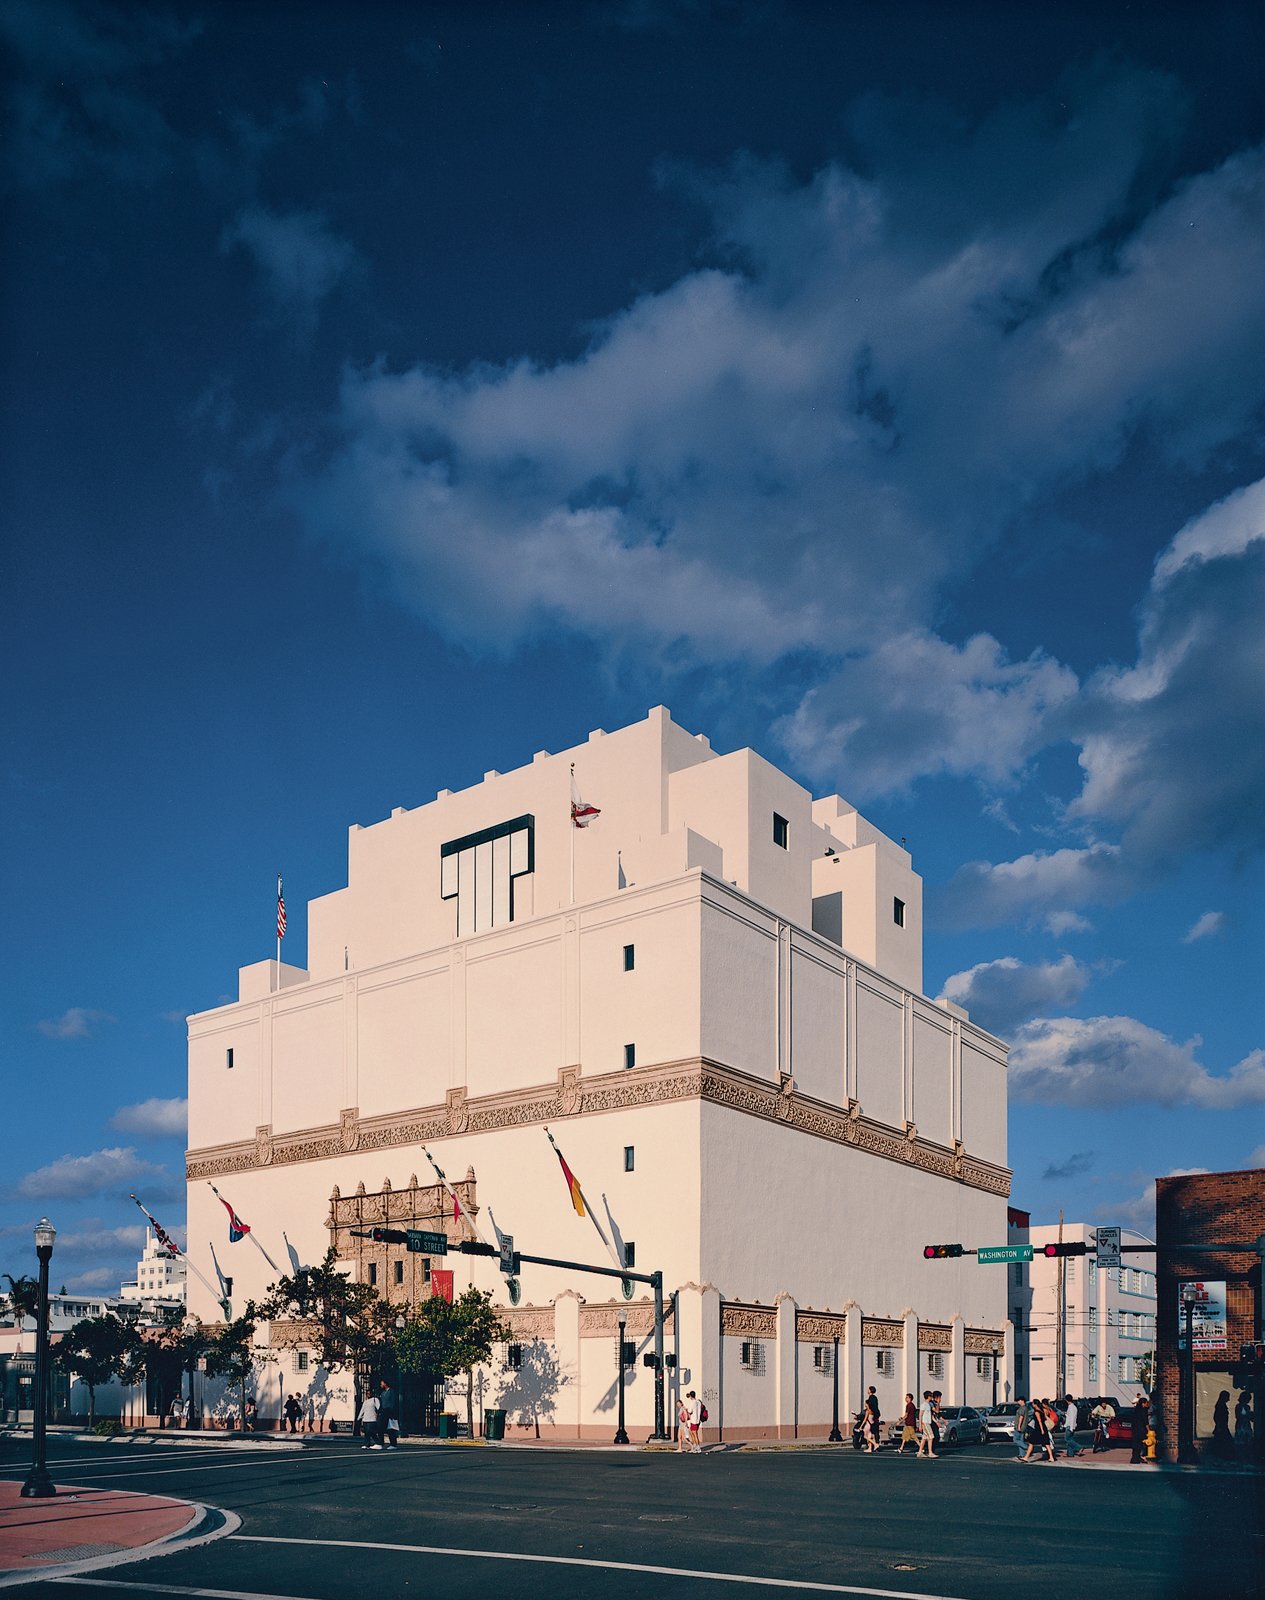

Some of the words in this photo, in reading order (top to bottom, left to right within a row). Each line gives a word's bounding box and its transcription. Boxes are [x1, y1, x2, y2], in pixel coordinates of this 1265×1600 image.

[411, 1239, 420, 1251] 10
[424, 1241, 445, 1253] STREET
[979, 1250, 1018, 1259] WASHINGTON
